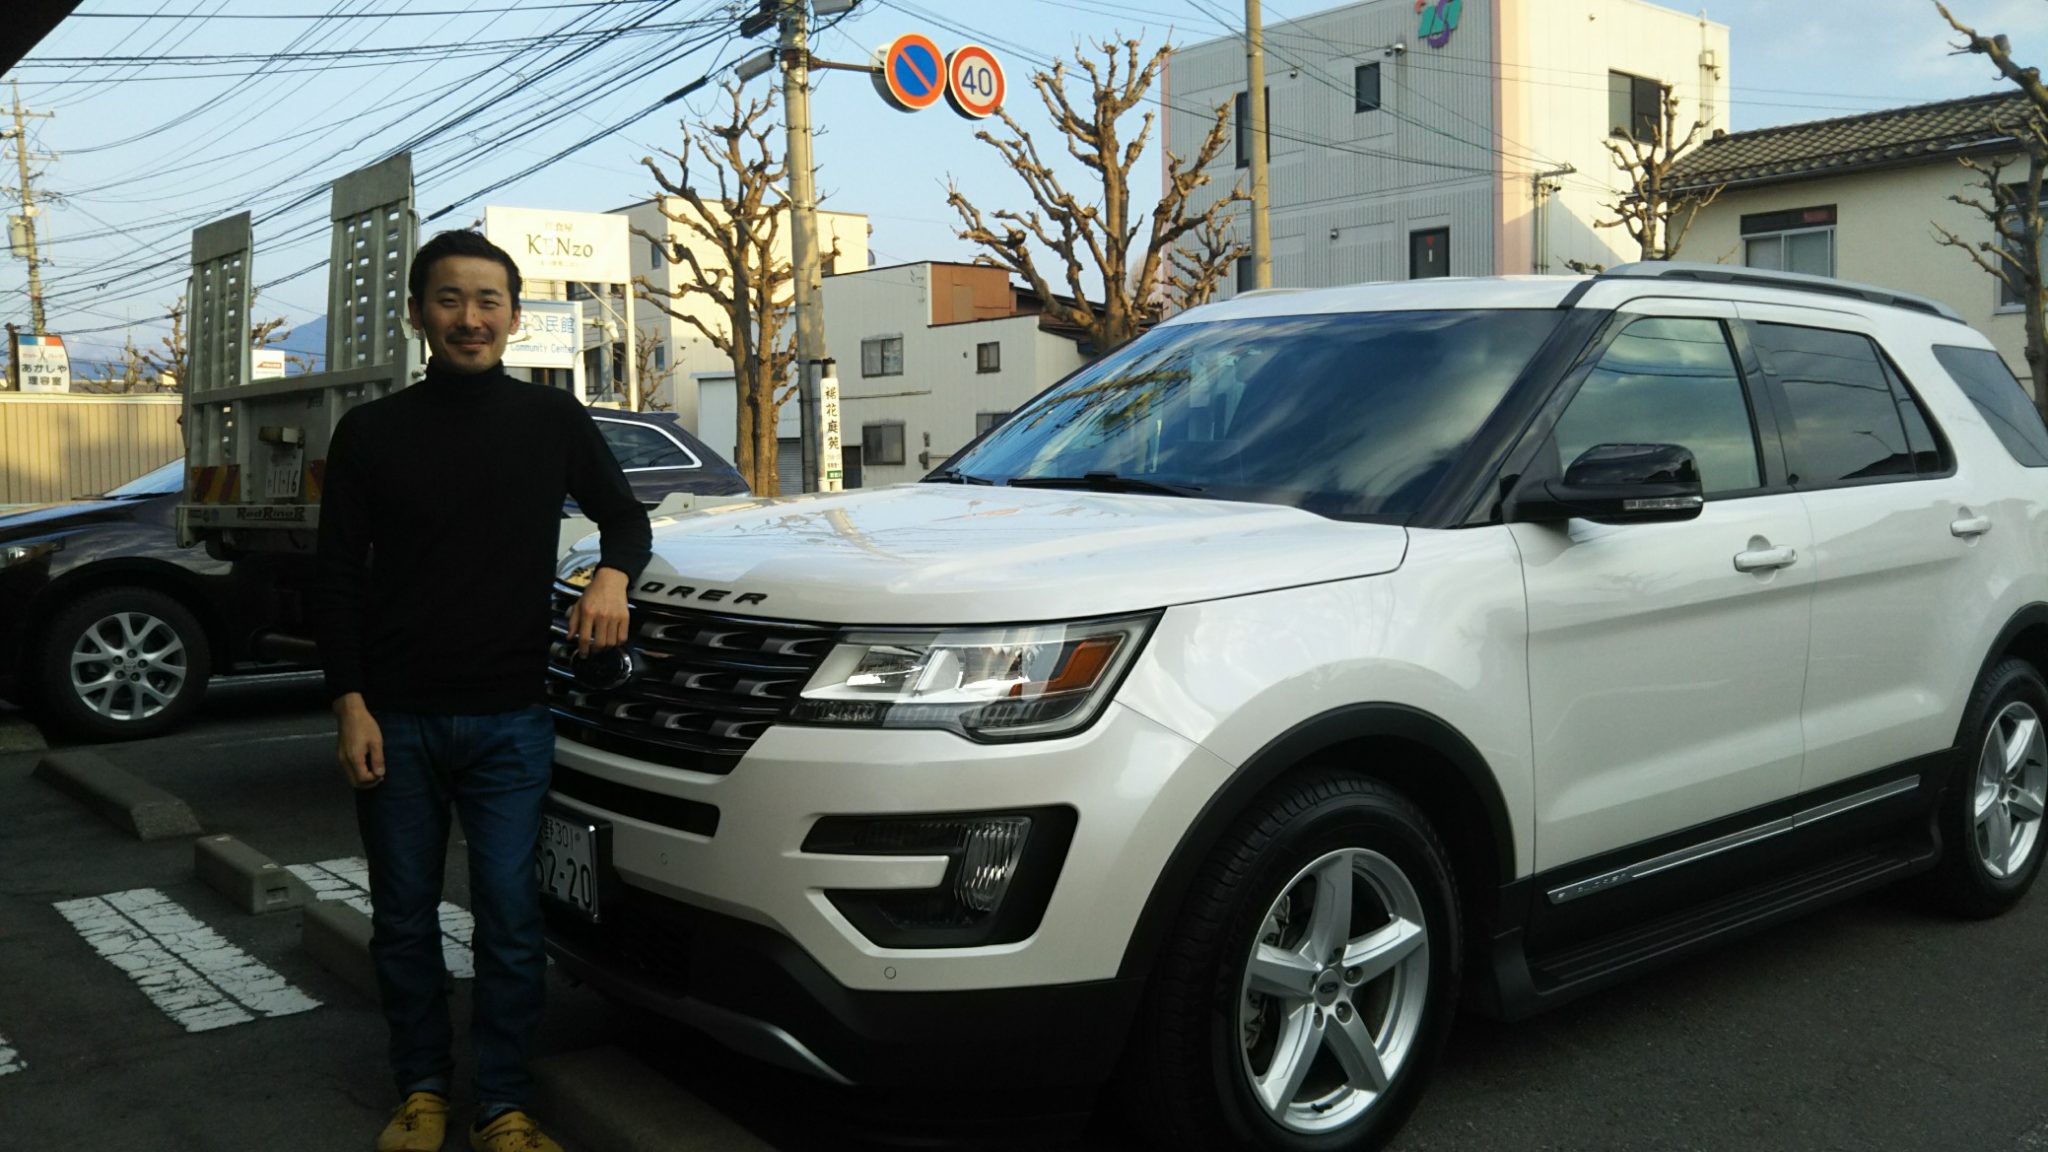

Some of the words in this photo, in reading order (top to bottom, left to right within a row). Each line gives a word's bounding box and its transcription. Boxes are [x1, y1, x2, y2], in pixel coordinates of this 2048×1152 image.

[961, 65, 993, 97] 40
[510, 342, 548, 354] Community
[551, 343, 576, 355] Center
[21, 363, 67, 374] あかしや
[638, 580, 769, 606] ORER
